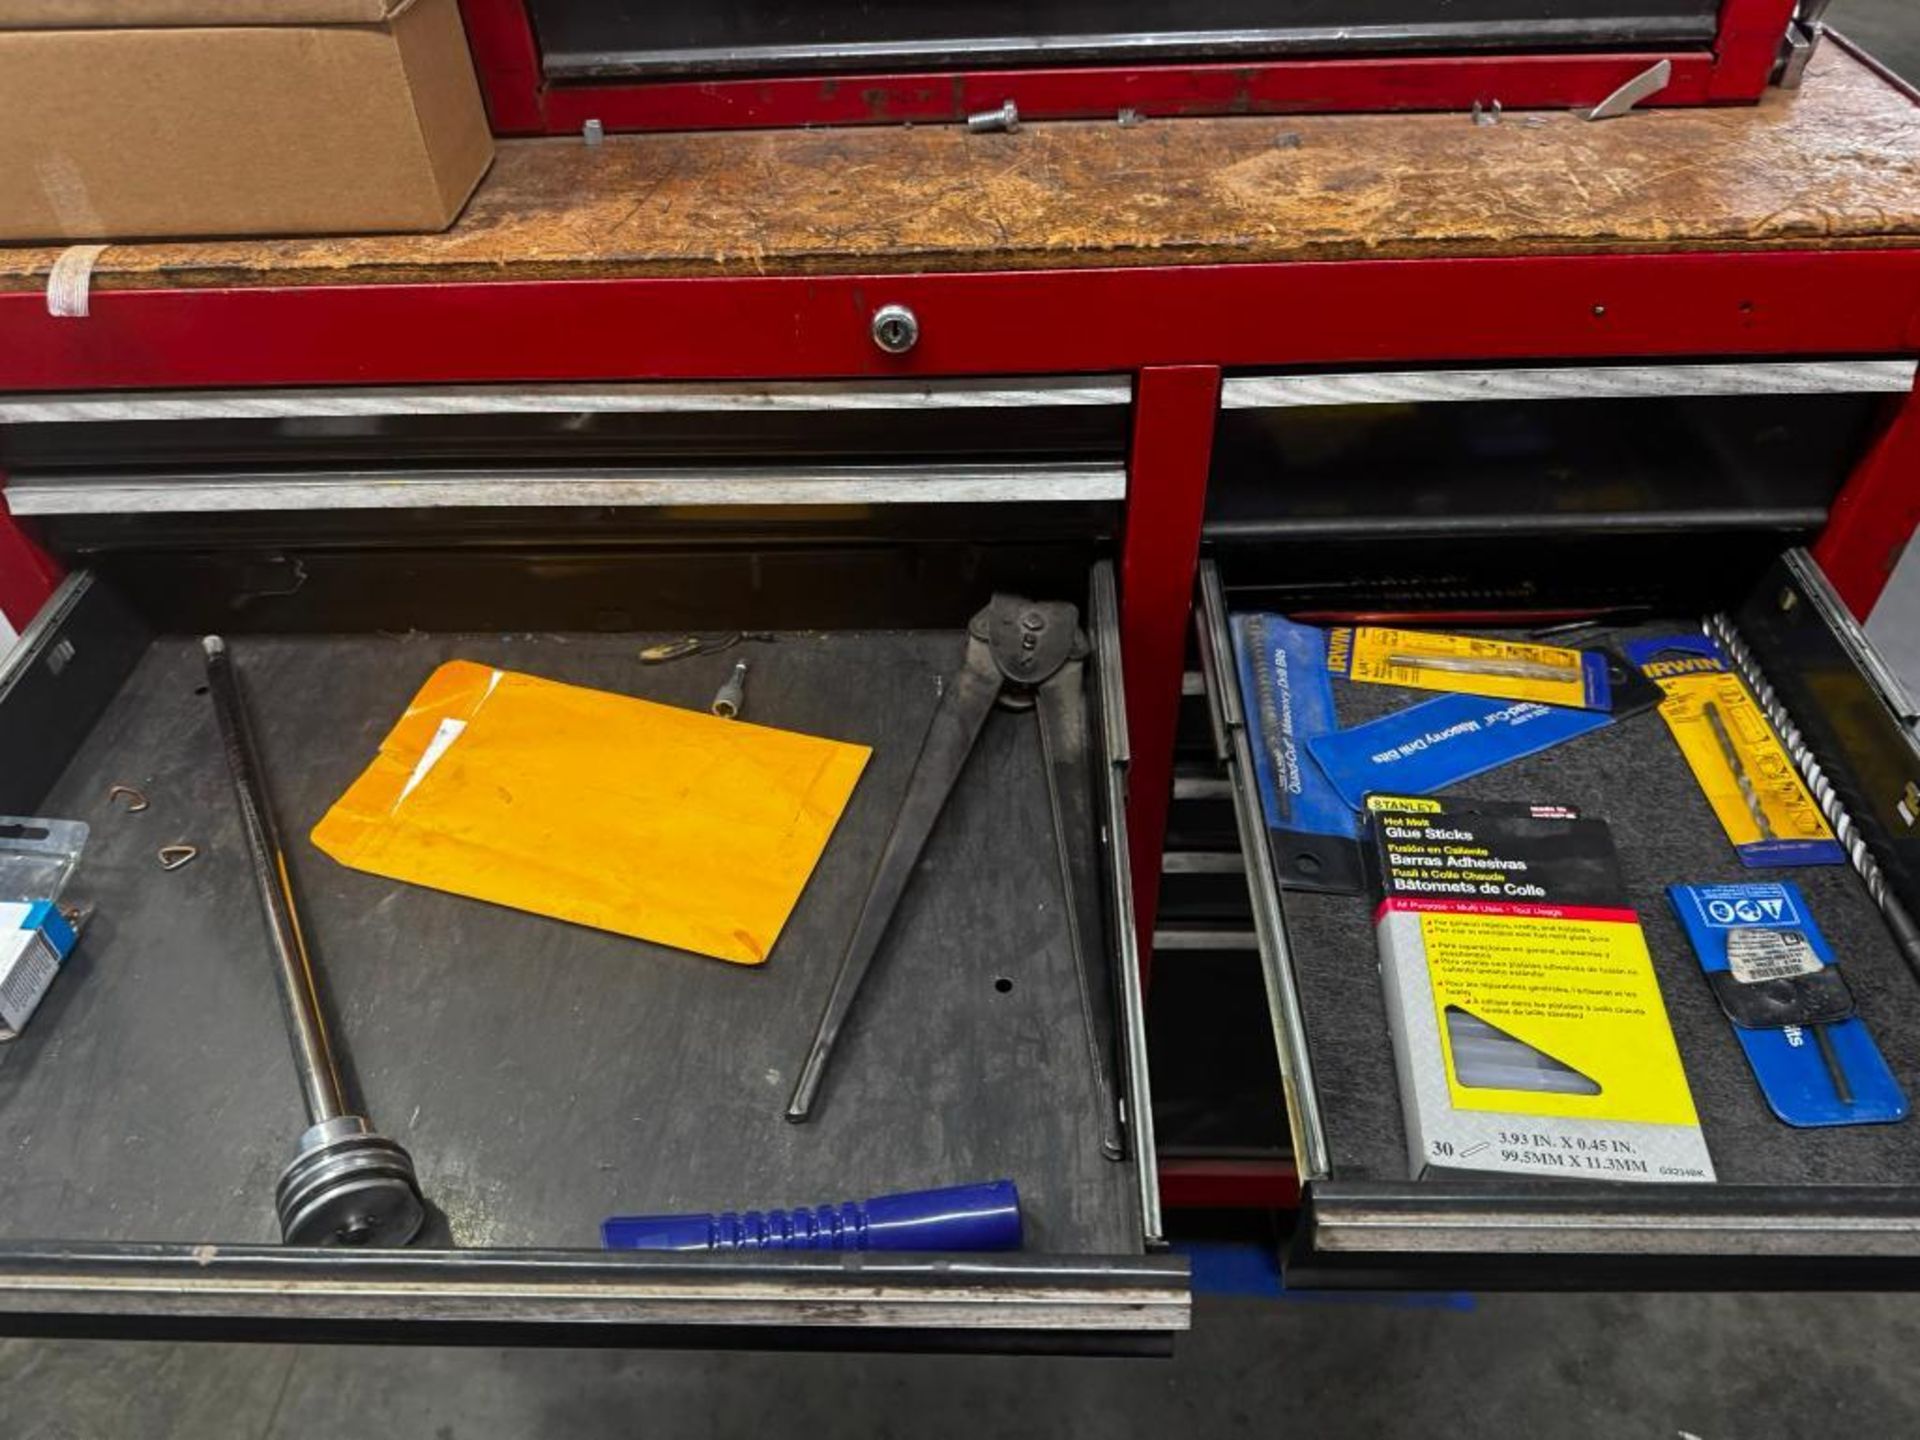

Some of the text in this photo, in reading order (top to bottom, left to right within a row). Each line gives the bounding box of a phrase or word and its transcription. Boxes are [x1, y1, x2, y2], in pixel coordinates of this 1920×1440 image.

[1327, 628, 1351, 672] IRWIN
[1641, 658, 1723, 678] IRWIN
[1281, 688, 1293, 737] Masonry
[1425, 720, 1482, 744] Masonry
[1372, 749, 1401, 763] Bits
[1398, 739, 1428, 757] Drill
[1373, 799, 1435, 813] STANLEY
[1383, 817, 1404, 827] Hot
[1385, 827, 1474, 841] Glue Sticks
[1427, 846, 1441, 854] en
[1443, 845, 1488, 856] Caliente
[1390, 853, 1527, 871] Barras Adhesivas
[1430, 869, 1460, 880] Colle
[1462, 870, 1505, 882] Chaude
[1394, 877, 1546, 897] Bâtonnets de Colle
[1432, 1140, 1454, 1157] 30
[1498, 1132, 1637, 1154] 3.93 IN. X 0.45 IN.
[1501, 1150, 1648, 1173] 99.5MM X 11.3MM
